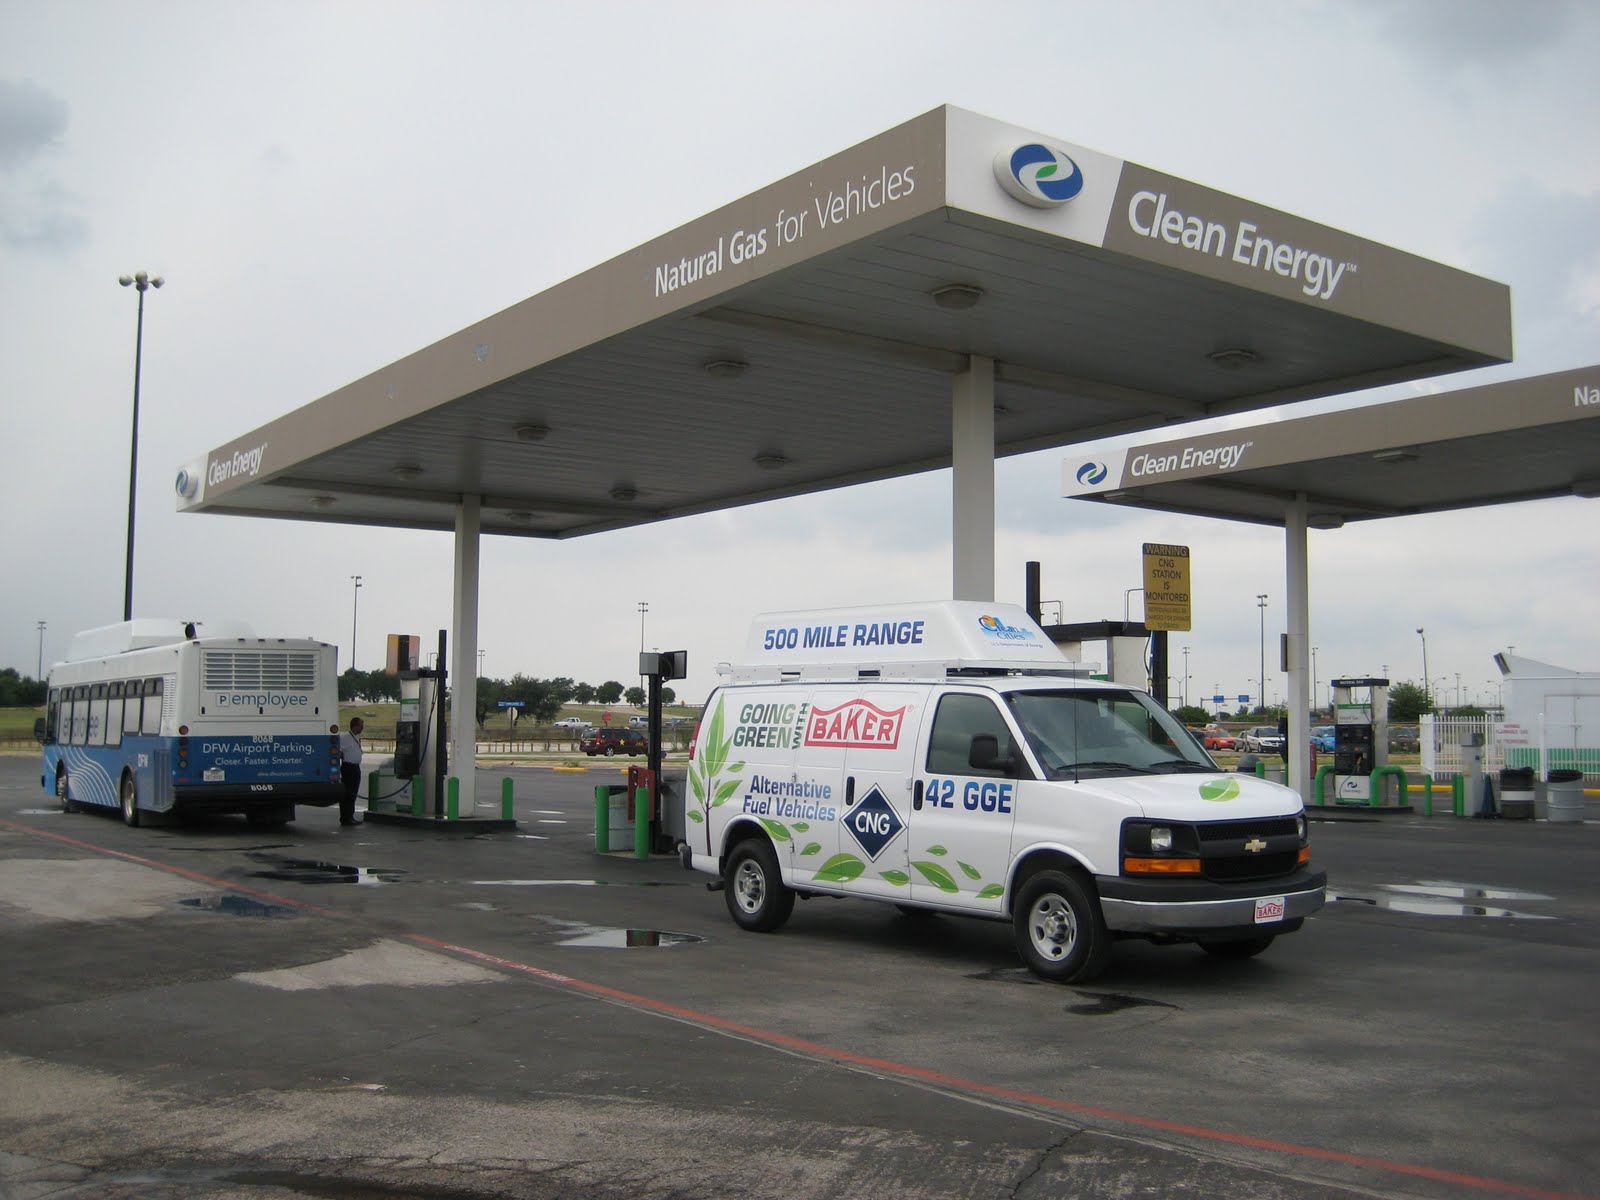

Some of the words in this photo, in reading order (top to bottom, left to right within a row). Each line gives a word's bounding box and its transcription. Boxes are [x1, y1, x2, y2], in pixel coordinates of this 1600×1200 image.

[655, 238, 723, 298] Natural
[729, 228, 767, 265] Gas
[775, 209, 808, 247] for
[815, 165, 915, 230] Vehicles
[1128, 191, 1227, 257] Clean
[1231, 221, 1345, 300] Energy
[208, 459, 231, 487] Clean
[231, 445, 264, 476] Energy
[1131, 454, 1177, 476] Clean
[1180, 443, 1246, 469] Energy
[1147, 545, 1186, 556] WARNING
[1153, 570, 1181, 579] STATION
[1159, 558, 1174, 568] CNG
[1146, 592, 1188, 602] MONITORED
[1163, 581, 1170, 590] IS
[764, 628, 797, 651] 500
[802, 625, 849, 648] MILE
[853, 620, 925, 646] RANGE
[997, 632, 1025, 640] Cities
[232, 691, 307, 708] employee
[739, 703, 796, 725] GOING
[812, 708, 895, 741] BAKER
[733, 726, 792, 749] GREEN
[791, 702, 810, 750] WITH
[203, 743, 230, 754] DFW
[233, 743, 271, 755] Airport
[215, 757, 242, 766] Closer.
[244, 757, 270, 765] Faster.
[272, 756, 304, 765] Smarter.
[750, 774, 832, 800] Alternative
[925, 779, 955, 809] 42
[963, 781, 1013, 814] GGE
[742, 795, 771, 816] Fuel
[776, 798, 836, 822] Vehicles
[855, 811, 890, 836] CNG
[1258, 905, 1281, 917] BAKER
